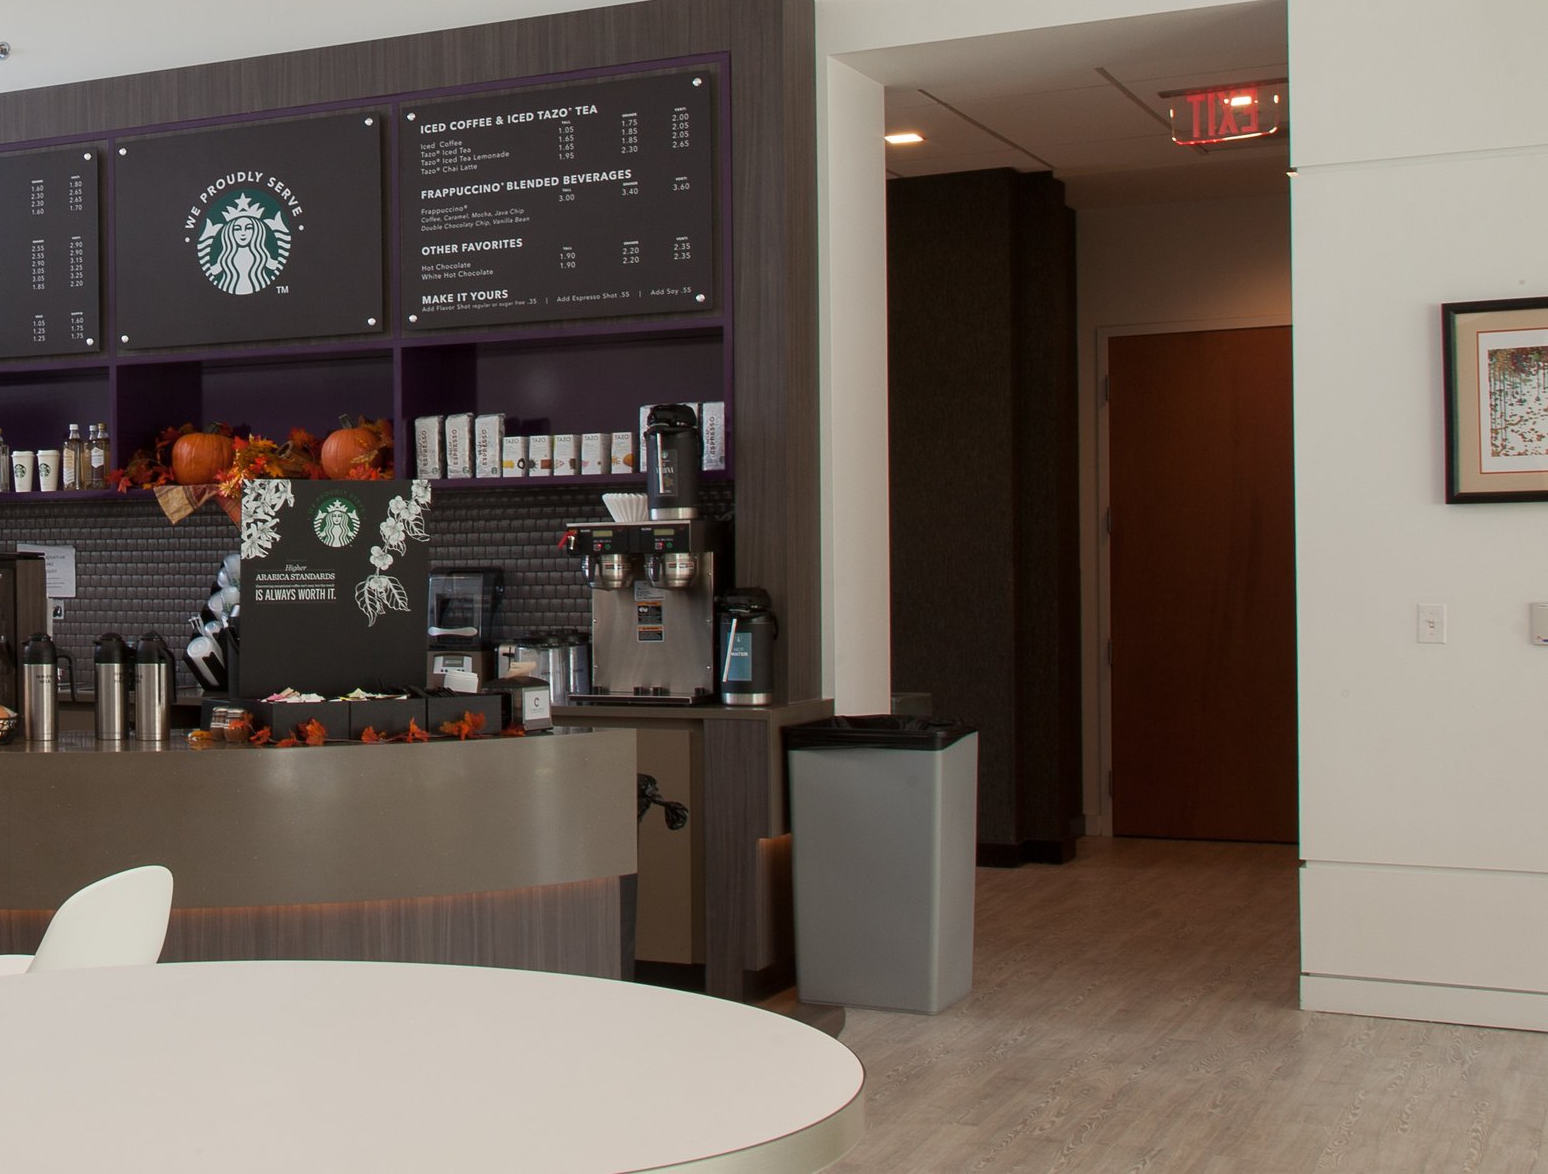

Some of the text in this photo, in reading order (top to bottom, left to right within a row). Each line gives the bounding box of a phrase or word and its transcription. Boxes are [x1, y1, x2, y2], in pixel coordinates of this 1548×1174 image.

[420, 123, 446, 134] ICED
[449, 117, 492, 131] COFFEE
[495, 116, 504, 125] &
[507, 112, 534, 124] ICED
[575, 105, 598, 116] TEA
[671, 113, 689, 121] 2.00
[621, 119, 638, 127] 1.75
[671, 122, 689, 130] 2.05
[558, 126, 574, 134] 1.05
[672, 131, 690, 139] 2.05
[439, 140, 463, 148] Coffee
[672, 140, 690, 148] 2.65
[442, 148, 458, 156] Iced
[621, 146, 638, 154] 2.30
[442, 156, 458, 164] Iced
[473, 151, 510, 161] Lemonade
[442, 165, 459, 173] Chai
[506, 177, 559, 191] BLENDED
[563, 169, 632, 185] BEVERAGES
[672, 183, 690, 191] 3.60
[185, 171, 303, 229] WE PROUDLY SERVE
[558, 194, 575, 202] 3.00
[421, 224, 443, 232] Double
[421, 238, 523, 256] OTHER FAVORITES
[622, 247, 640, 255] 2.20
[622, 256, 640, 264] 2.20
[673, 252, 691, 260] 2.35
[435, 262, 472, 270] Chocolate
[457, 269, 494, 277] Chocolate
[422, 289, 509, 305] MAKE IT YOURS
[572, 294, 601, 302] Espresso
[285, 564, 307, 572] Higher
[290, 573, 336, 581] STANDARDS
[255, 588, 337, 601] IS ALWAYS WORTH IT.
